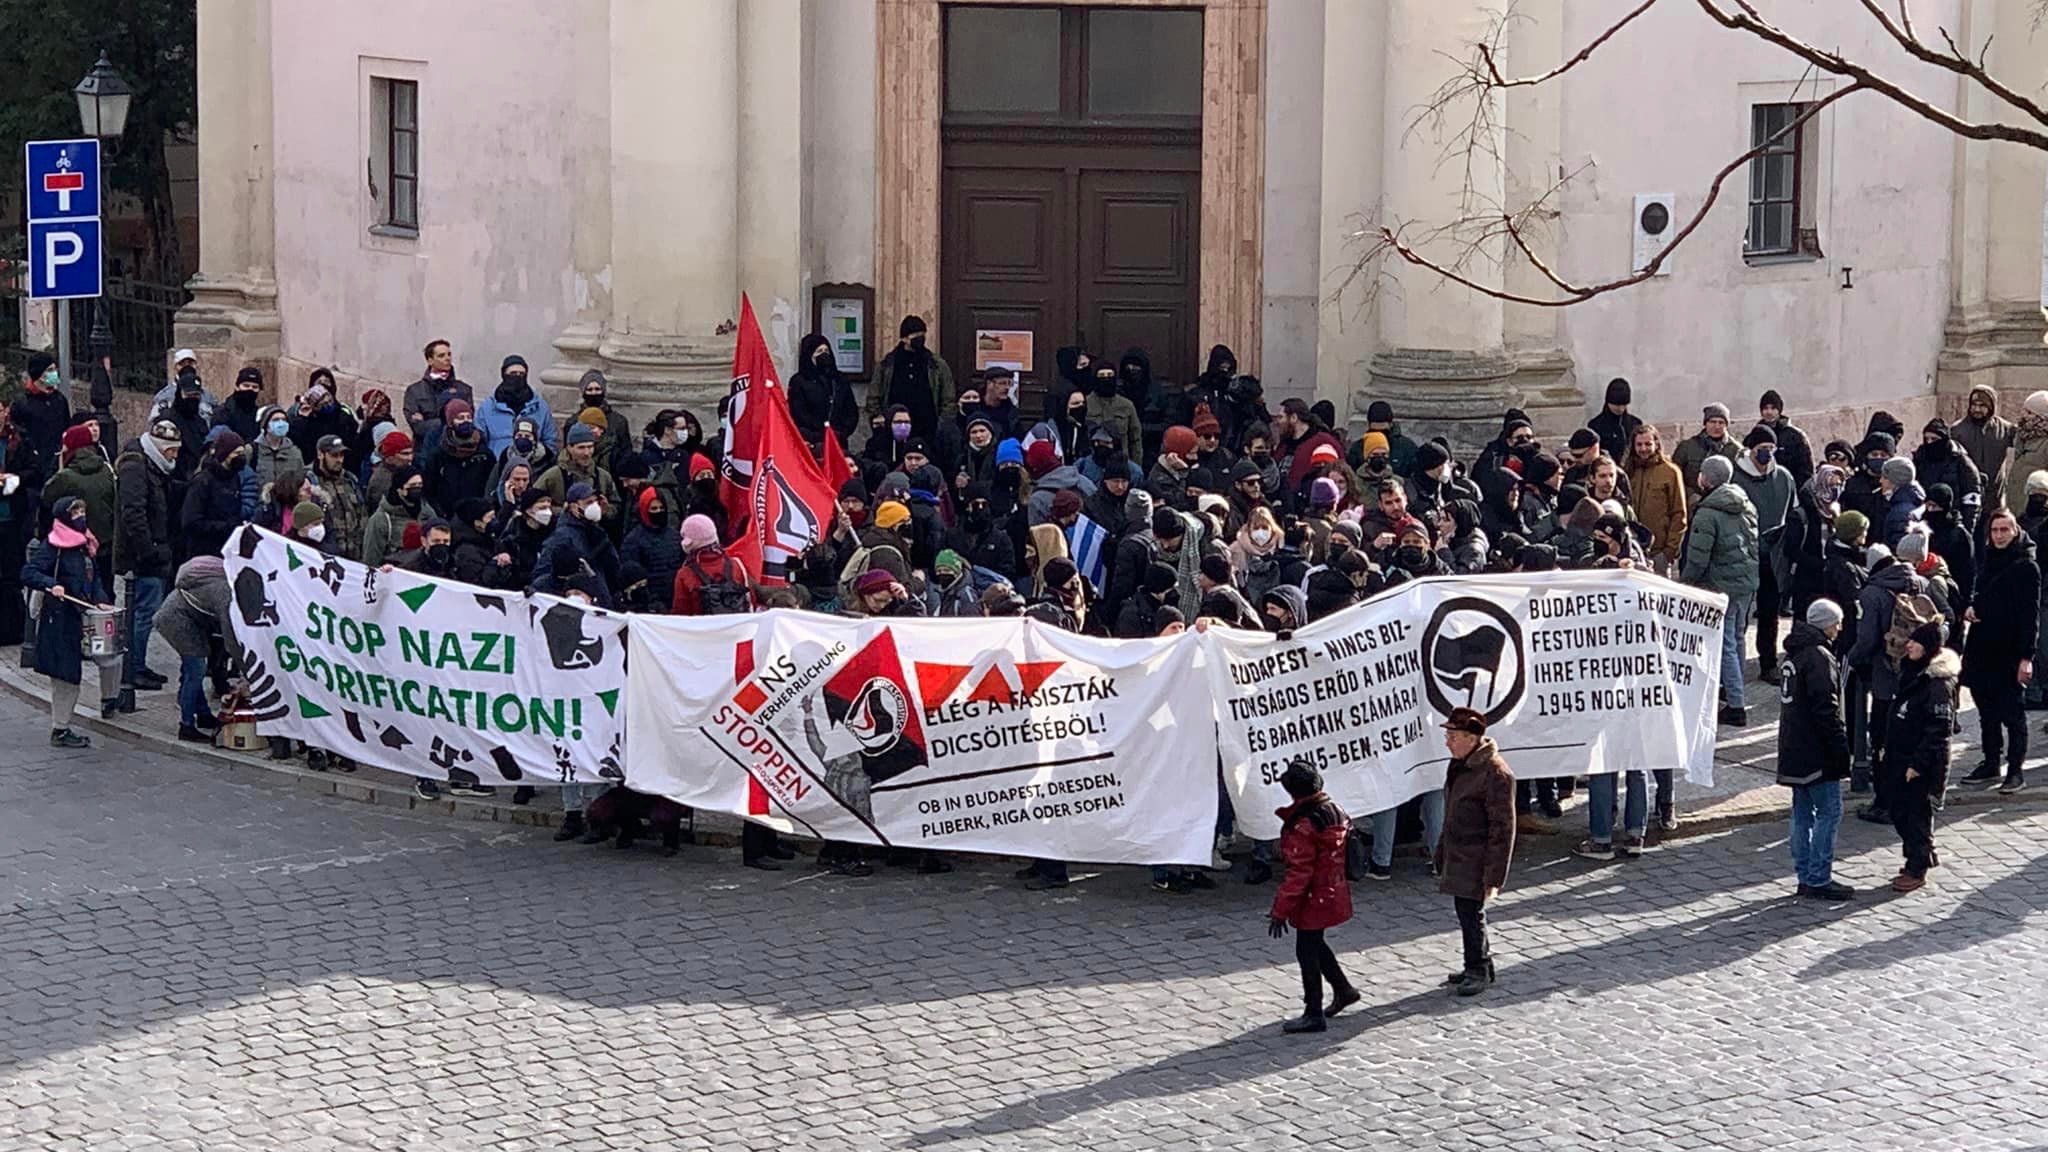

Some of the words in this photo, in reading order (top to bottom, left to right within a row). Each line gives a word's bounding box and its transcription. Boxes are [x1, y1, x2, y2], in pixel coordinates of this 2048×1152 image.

[46, 231, 84, 288] P
[1529, 592, 1618, 620] BUDAPEST
[1637, 591, 1675, 618] KEINE
[305, 601, 386, 657] STOP
[399, 626, 516, 674] NAZI
[1230, 647, 1309, 685] BUDAPEST
[1324, 629, 1377, 662] NINCS
[1378, 619, 1411, 645] BIZ-
[1531, 625, 1608, 653] FESTUNG
[1615, 620, 1645, 645] FÜR
[1651, 621, 1678, 650] NZIS
[274, 635, 582, 741] GLORIFICATION!
[753, 641, 846, 726] VERHERRLICHUNG
[758, 654, 797, 693] NS
[1228, 684, 1310, 721] TONSÁGOS
[1363, 666, 1374, 688] A
[1375, 649, 1421, 684] NÁCIK
[1535, 660, 1574, 684] IHRE
[1579, 653, 1663, 681] FREUNDE!
[1667, 661, 1692, 686] DER
[924, 698, 980, 727] ELÉG
[988, 695, 1003, 715] A
[1008, 676, 1119, 712] FASISZTÁK
[1247, 726, 1268, 753] ÉS
[1271, 708, 1346, 748] BARÁTAIK
[1350, 686, 1419, 727] SZÁMÁRA
[1537, 690, 1585, 716] 1945
[1592, 688, 1634, 711] NOCH
[1642, 685, 1673, 708] HEU
[712, 705, 812, 801] STOPPEN
[1261, 759, 1282, 785] SE
[1381, 727, 1401, 753] SE
[918, 799, 941, 814] OB
[945, 796, 961, 811] IN
[965, 783, 1045, 809] BUDAPEST,
[1048, 772, 1121, 796] DRESDEN,
[922, 815, 990, 838] PLIBERK,
[992, 809, 1031, 826] RIGA
[1033, 803, 1071, 821] ODER
[1075, 793, 1125, 815] SOFIA!
